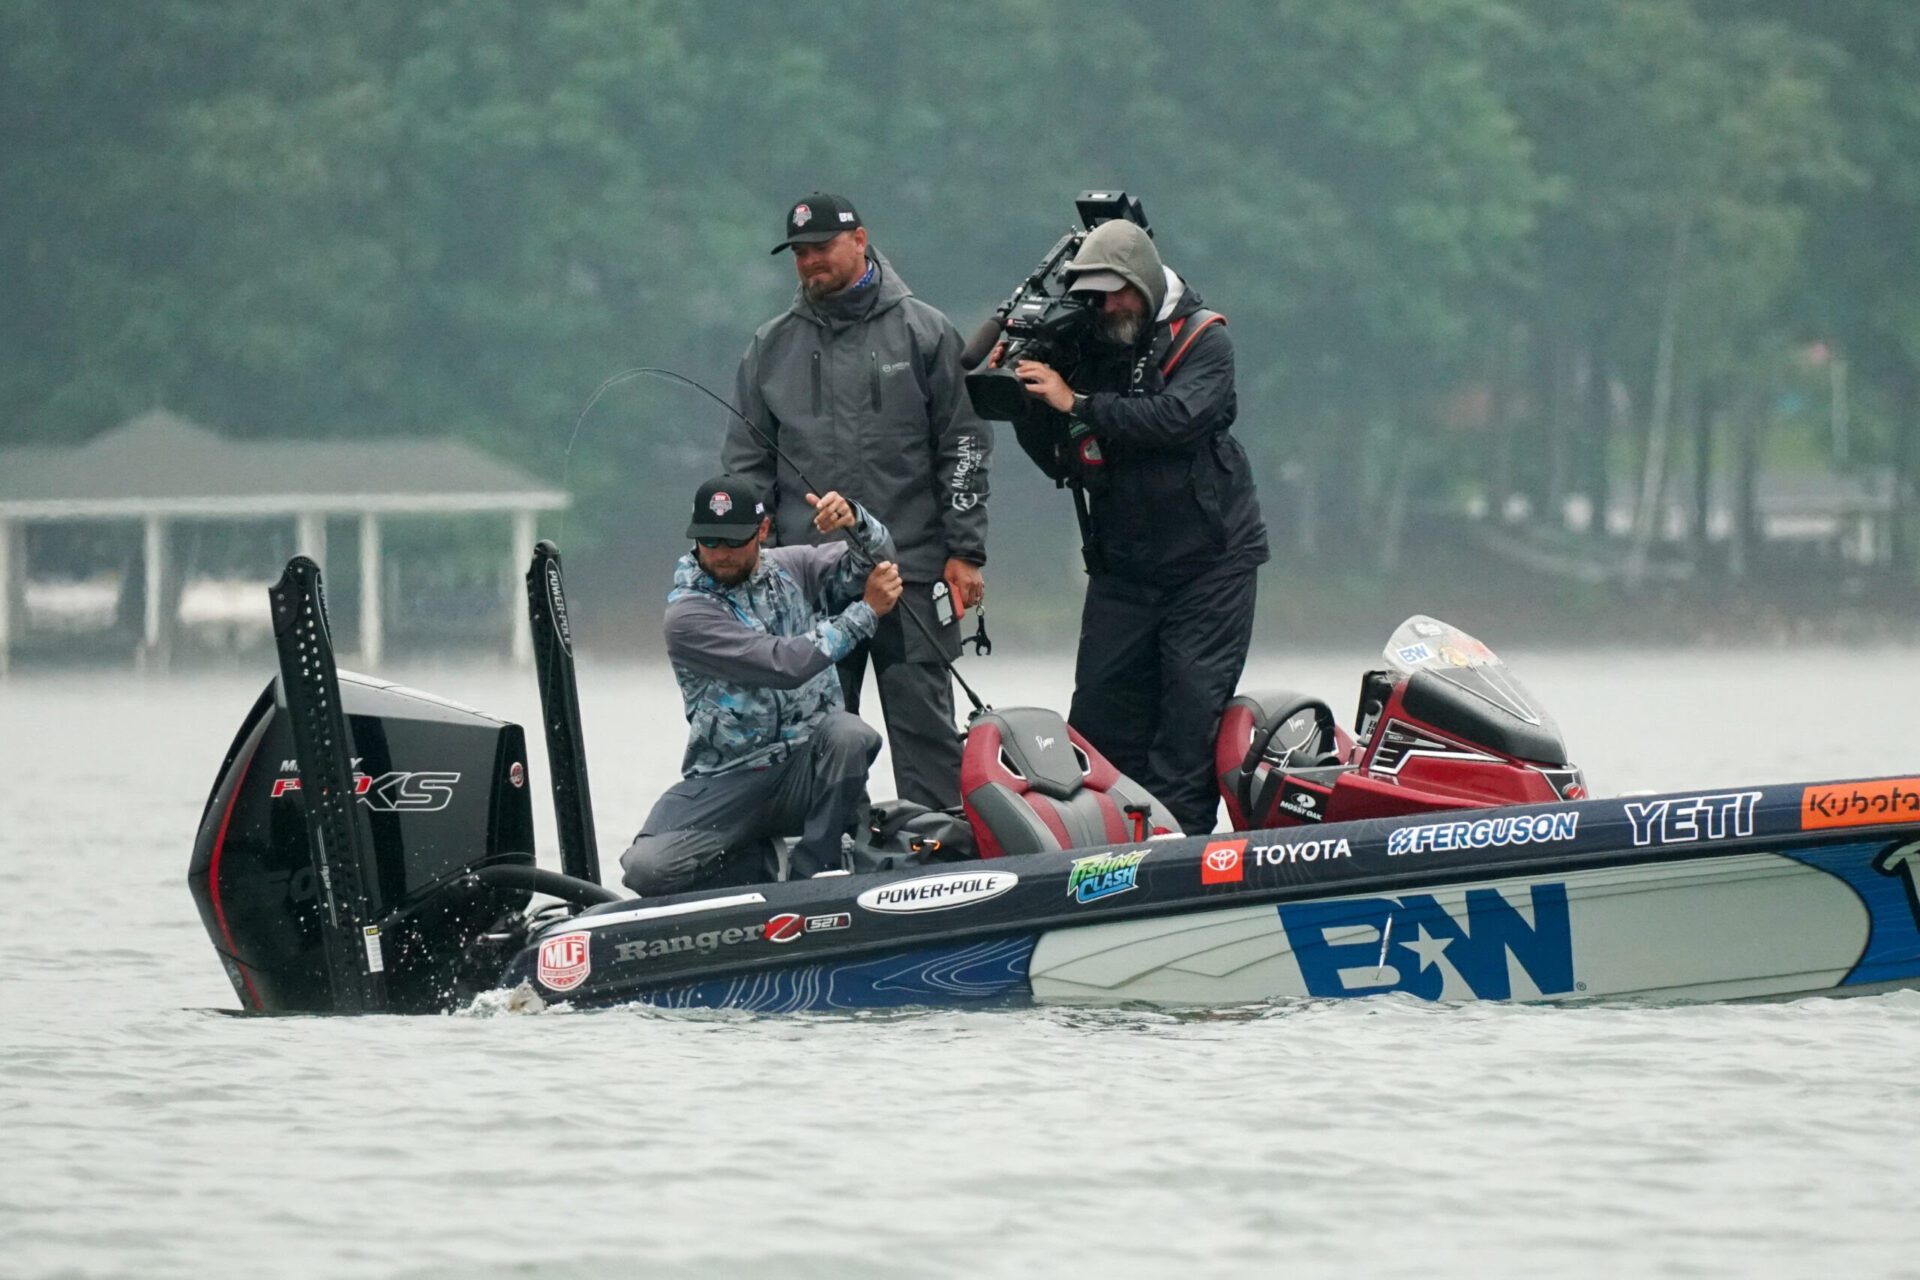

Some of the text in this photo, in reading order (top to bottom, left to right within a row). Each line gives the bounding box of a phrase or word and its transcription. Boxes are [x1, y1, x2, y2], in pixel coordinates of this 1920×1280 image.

[548, 569, 571, 644] POWER-POLE
[1280, 800, 1323, 820] MOSSY OAK
[1624, 791, 1763, 846] YETI
[1810, 786, 1920, 817] Kubota
[1411, 812, 1579, 854] FERGUSON
[1069, 850, 1146, 891] FISHING
[1252, 839, 1352, 866] TOYOTA
[876, 877, 998, 905] POWER-POLE
[1078, 865, 1136, 901] CLASH
[545, 942, 584, 969] MLF
[614, 922, 766, 963] Ranger
